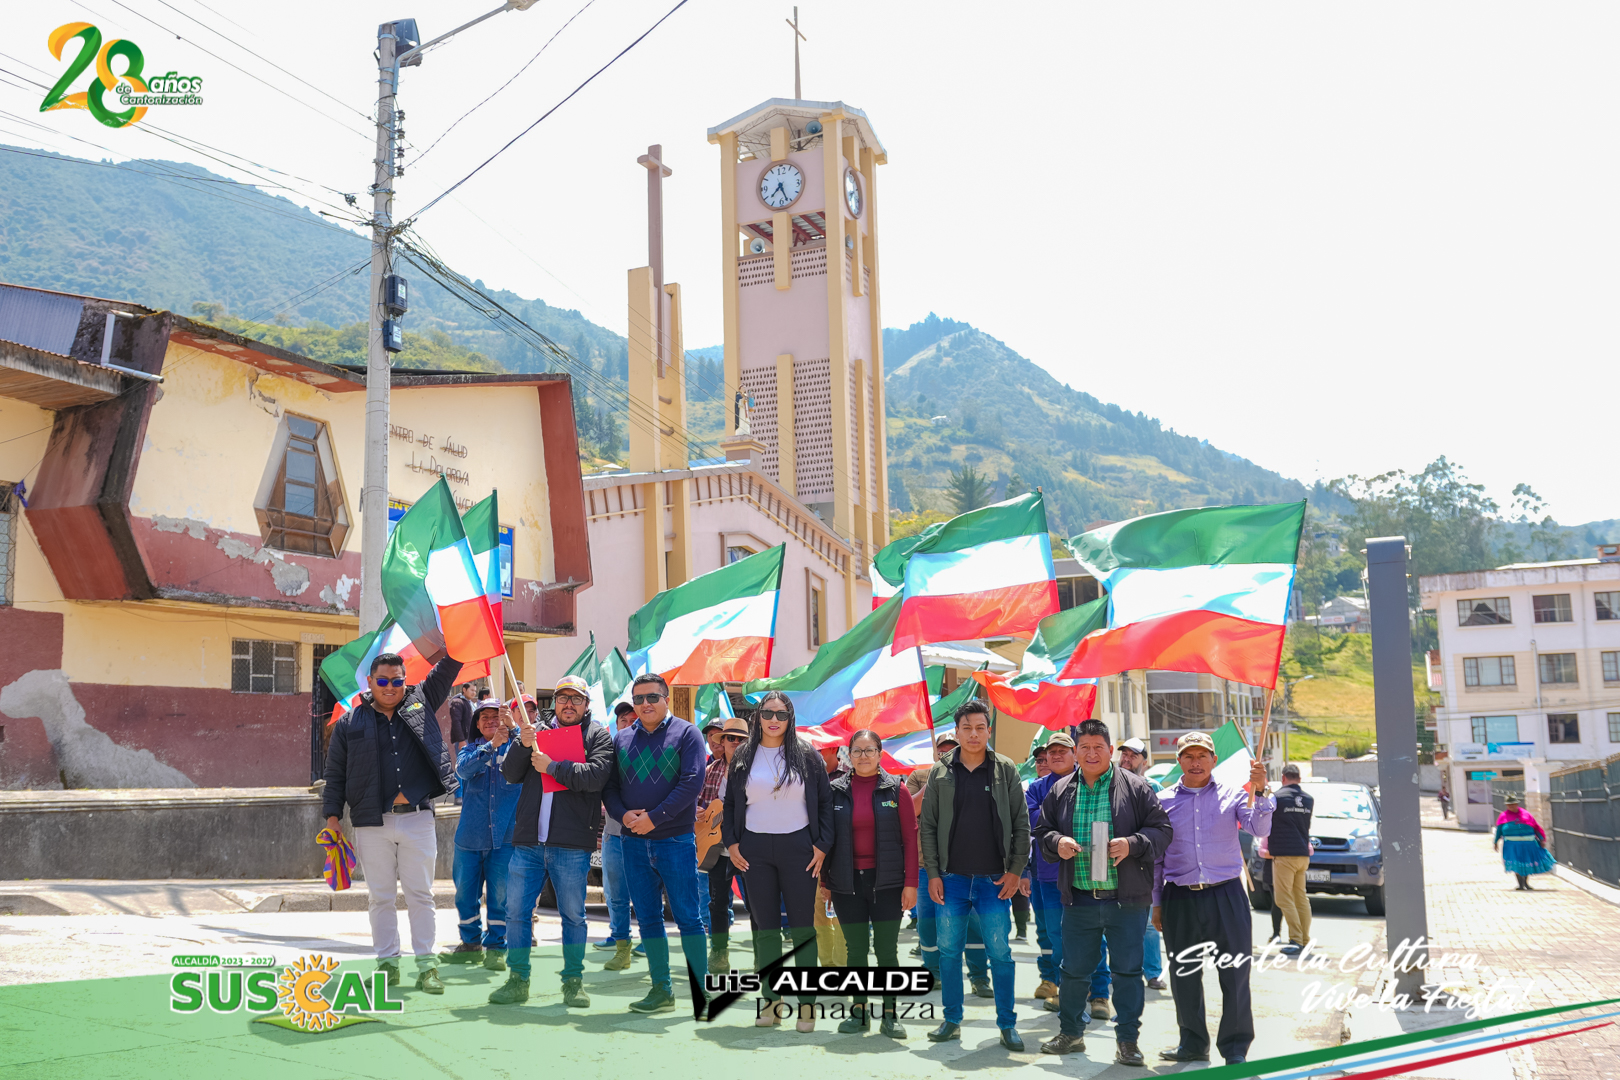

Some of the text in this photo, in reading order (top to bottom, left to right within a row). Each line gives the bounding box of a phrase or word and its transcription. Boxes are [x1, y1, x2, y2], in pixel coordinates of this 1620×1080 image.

[777, 166, 786, 175] 12
[795, 179, 800, 187] 3
[779, 198, 785, 206] 6
[389, 423, 468, 459] ENTRO DE SALUD
